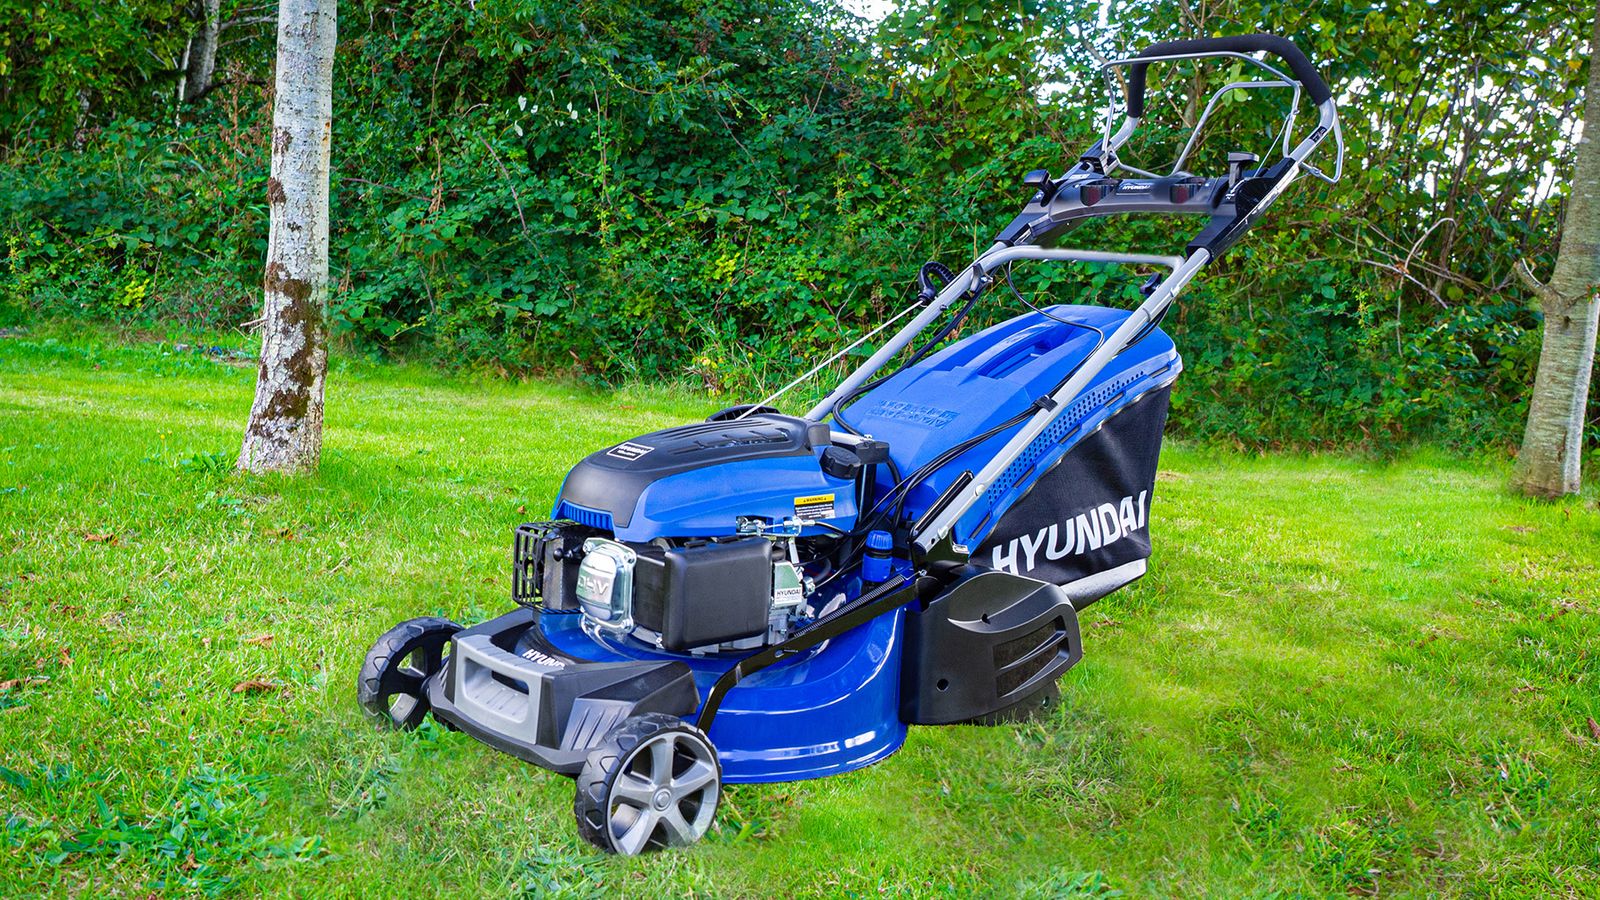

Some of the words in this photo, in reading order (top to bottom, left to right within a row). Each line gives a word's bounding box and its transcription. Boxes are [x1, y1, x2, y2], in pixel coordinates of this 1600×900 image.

[992, 489, 1148, 576] HYUNDAI
[577, 575, 610, 596] OHV
[776, 588, 801, 597] HYUNDAI
